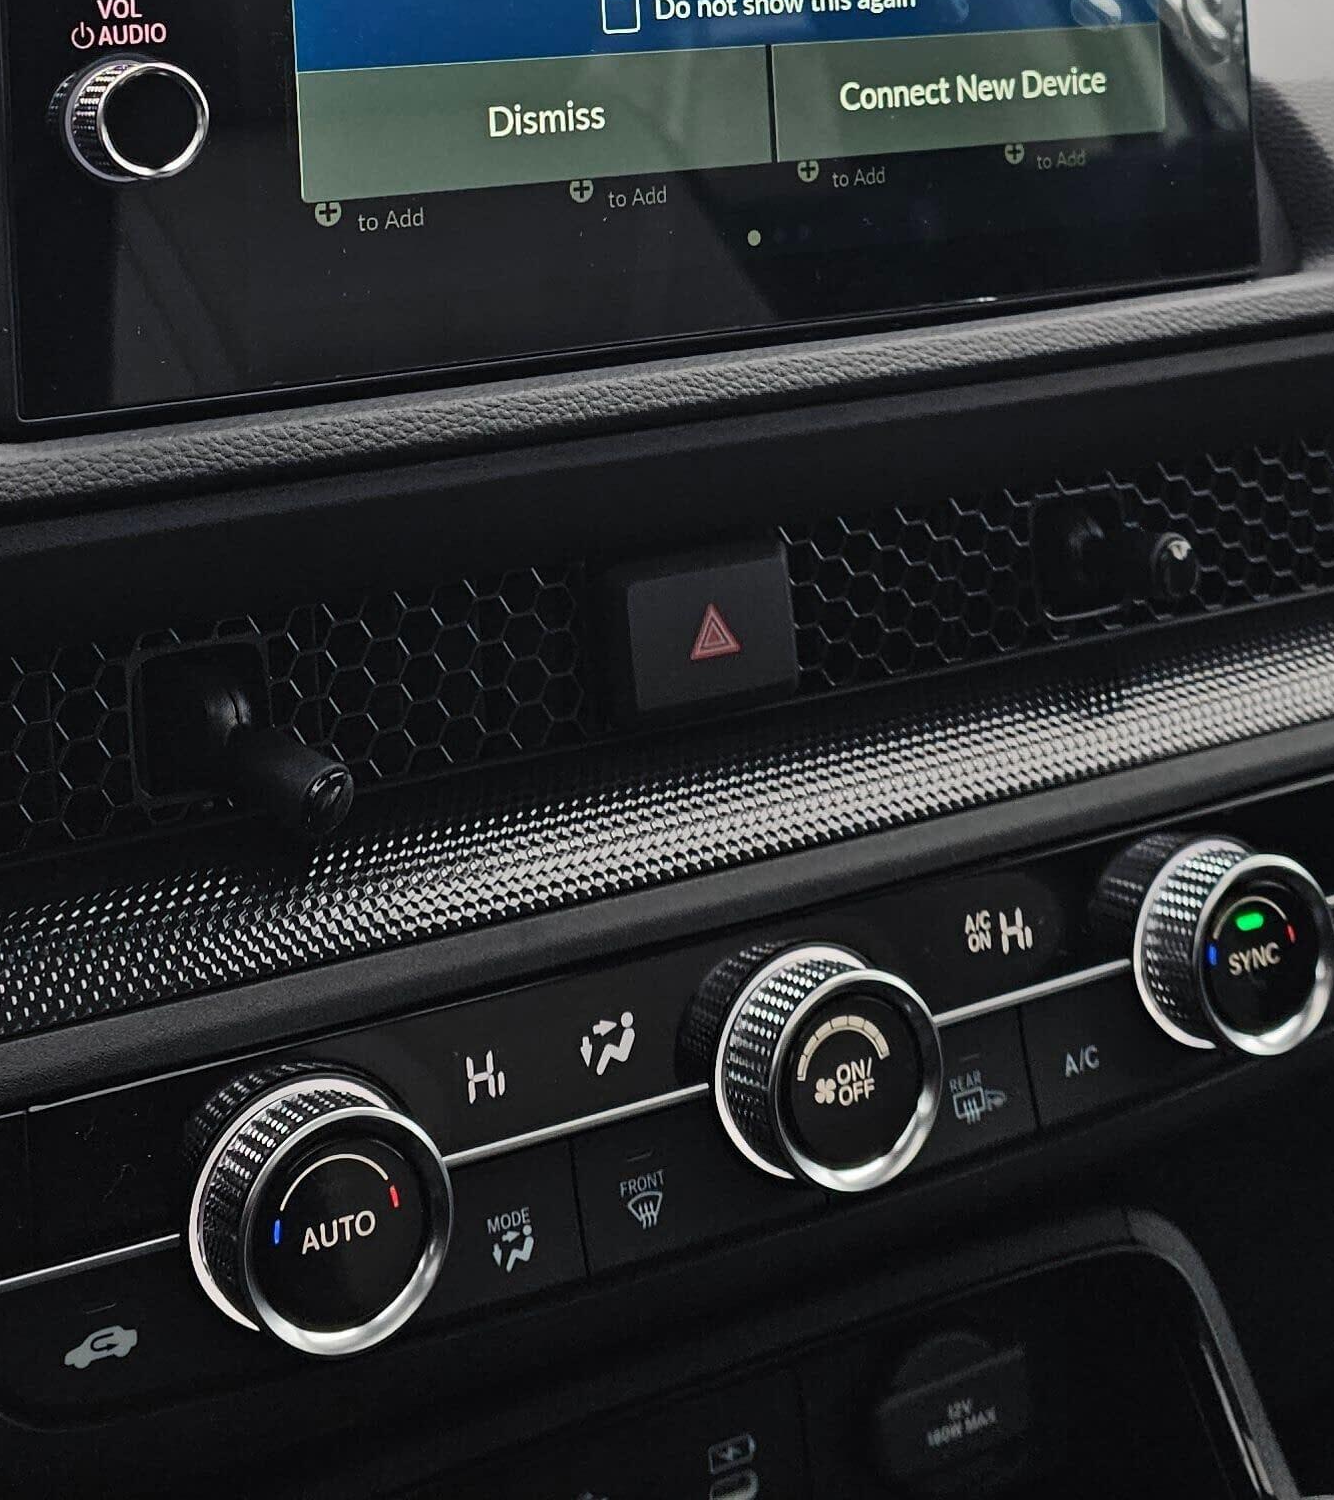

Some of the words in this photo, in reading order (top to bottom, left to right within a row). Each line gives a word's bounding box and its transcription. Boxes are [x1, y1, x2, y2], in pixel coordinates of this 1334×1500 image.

[97, 22, 168, 46] AUDIO
[839, 76, 951, 112] Connect
[956, 72, 1016, 105] New
[1020, 66, 1108, 100] Device
[488, 100, 607, 138] Dismiss
[1036, 153, 1053, 171] to
[1056, 149, 1087, 169] Add
[831, 171, 850, 188] to
[853, 166, 886, 187] Add
[607, 190, 628, 209] to
[631, 185, 668, 207] Add
[357, 212, 379, 233] to
[384, 207, 425, 231] Add
[963, 910, 992, 935] A/C
[967, 933, 992, 955] ON
[1228, 941, 1282, 977] SYNC
[835, 1056, 873, 1088] ON/
[1064, 1043, 1101, 1079] A/C
[837, 1078, 876, 1108] OFF
[948, 1068, 982, 1093] REAR
[619, 1168, 665, 1200] FRONT
[300, 1209, 377, 1256] AUTO
[485, 1206, 532, 1235] MODE
